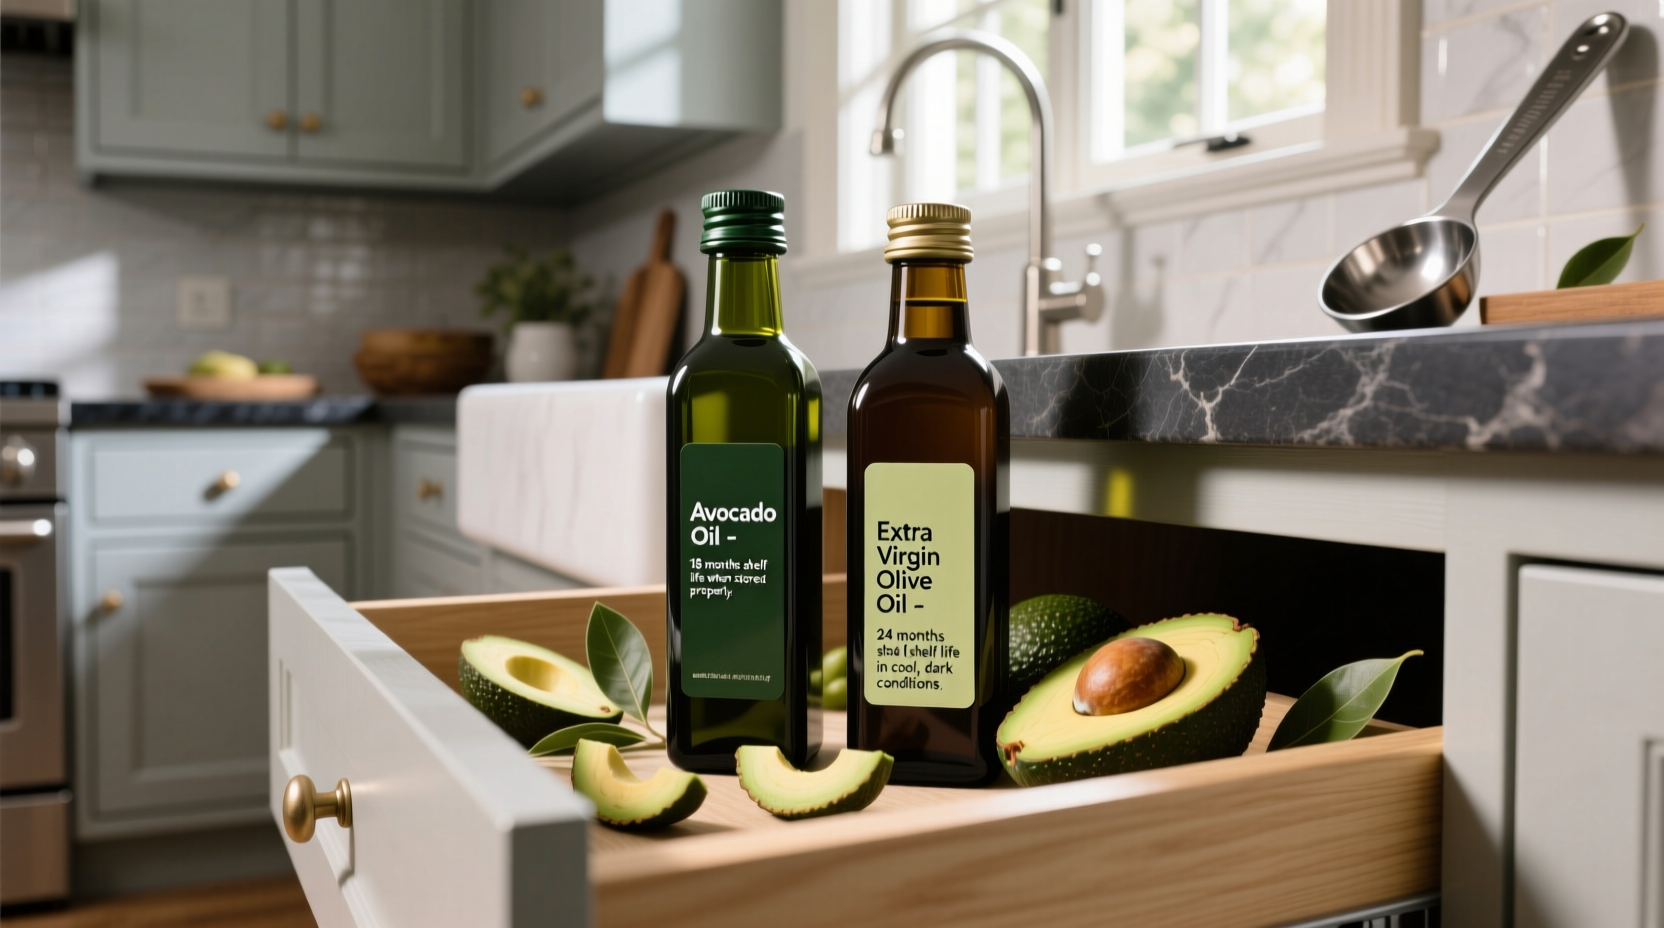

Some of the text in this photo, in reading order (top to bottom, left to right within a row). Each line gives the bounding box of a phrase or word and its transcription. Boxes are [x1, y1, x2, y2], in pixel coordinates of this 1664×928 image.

[690, 501, 777, 522] Avocado
[691, 525, 720, 546] Oil
[877, 520, 933, 542] Extra
[877, 545, 940, 571] Virgin
[876, 569, 933, 590] Olive
[876, 593, 907, 614] Oil
[876, 628, 945, 642] 24 months
[940, 645, 960, 658] life
[876, 661, 954, 676] in cool, dark
